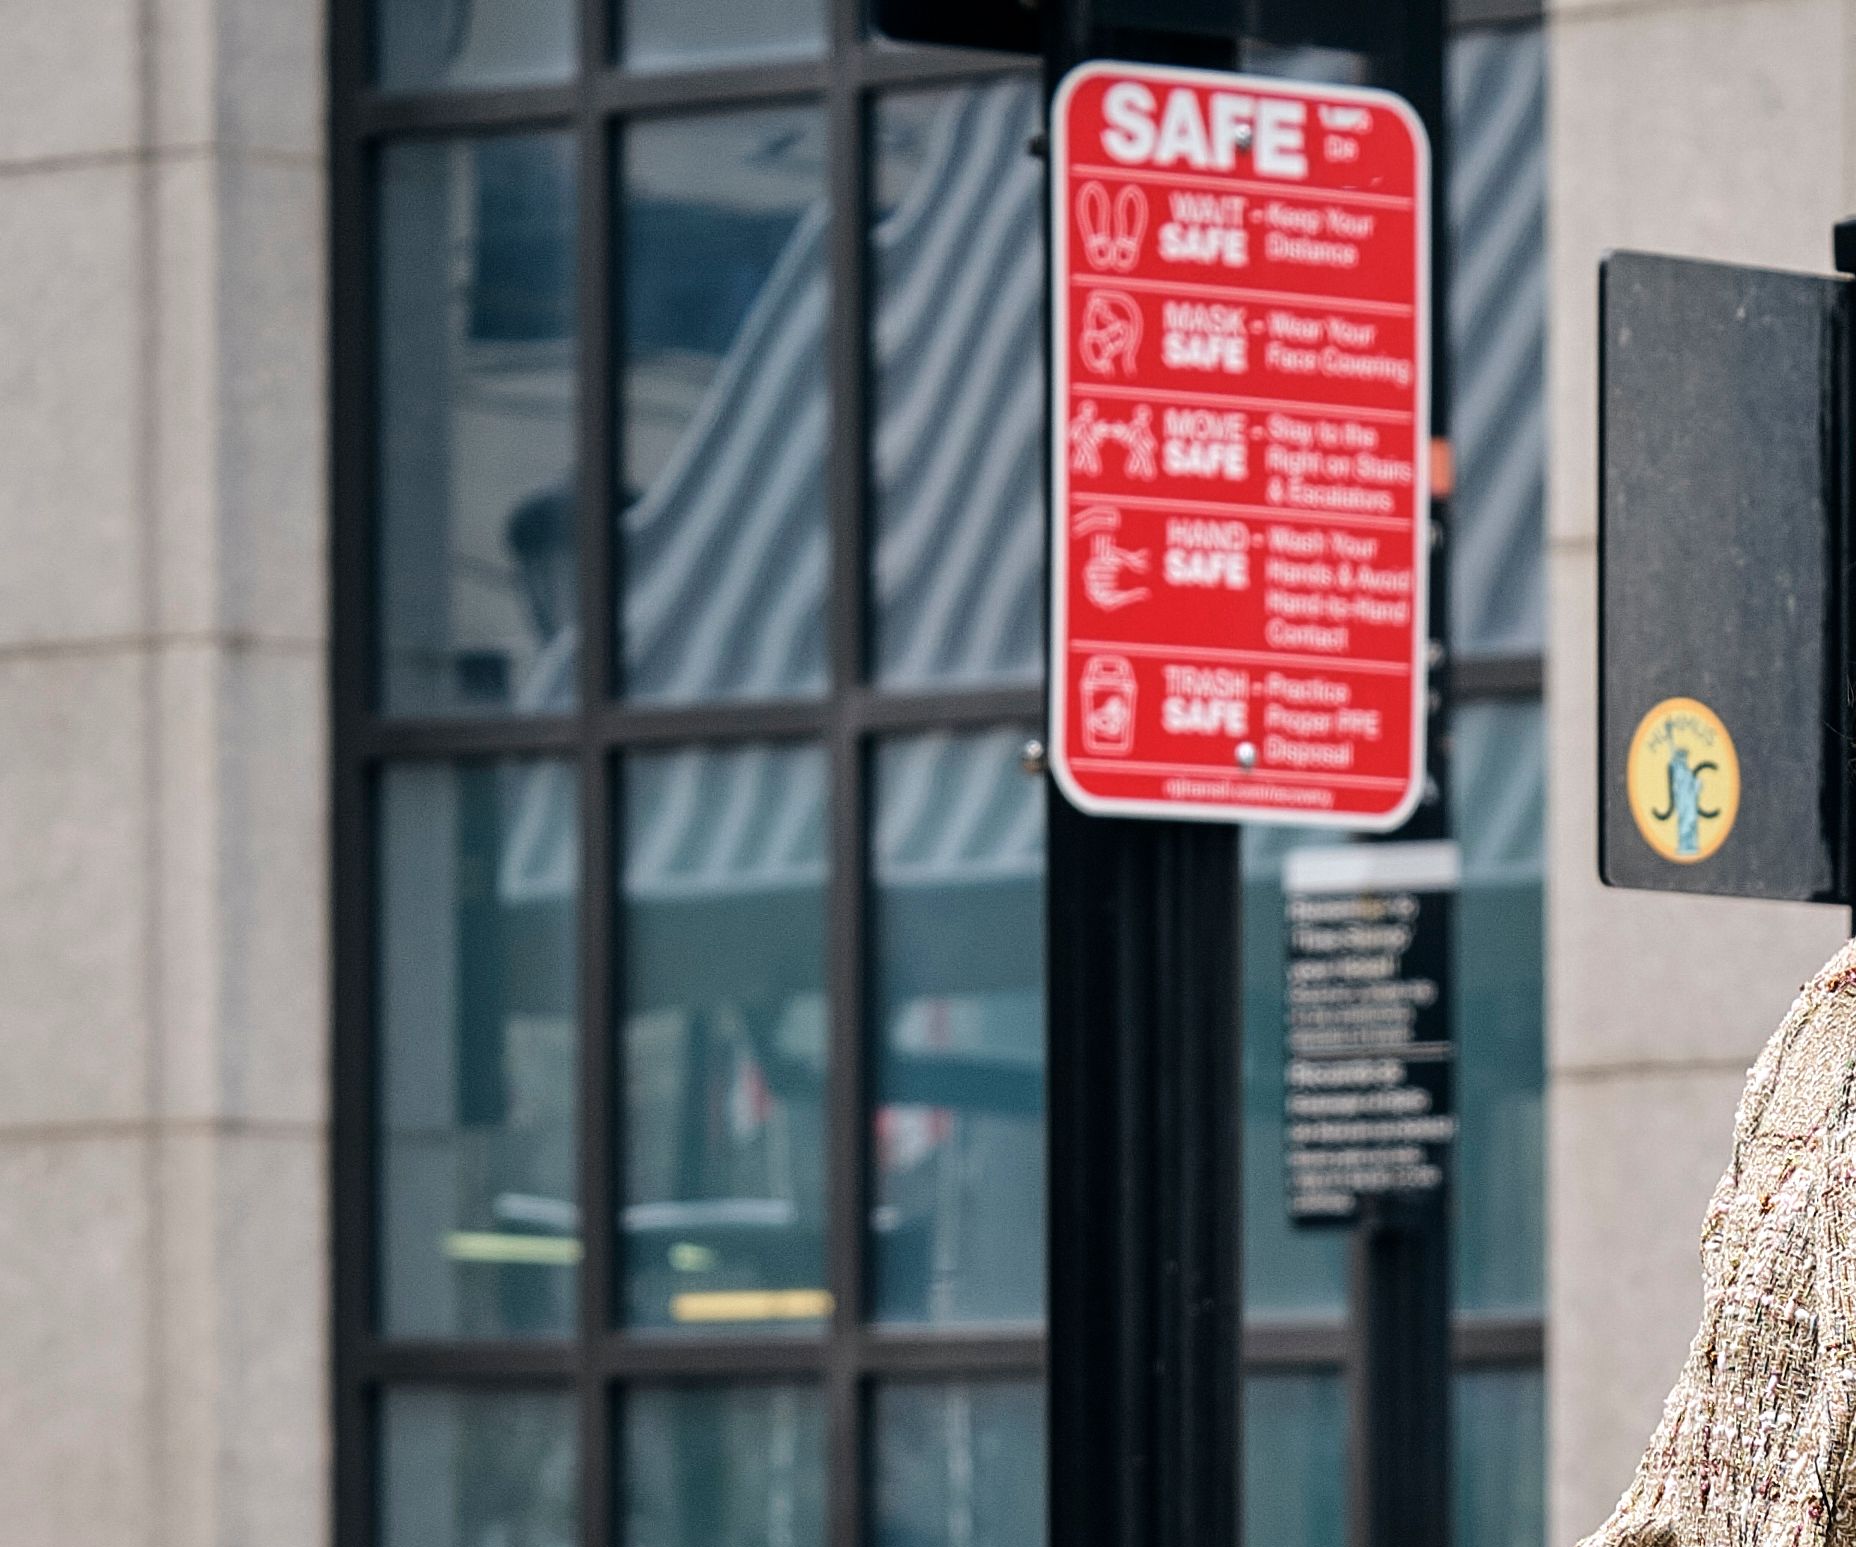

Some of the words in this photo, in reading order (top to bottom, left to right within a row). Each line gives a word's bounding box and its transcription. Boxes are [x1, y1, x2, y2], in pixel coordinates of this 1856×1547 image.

[1103, 83, 1307, 177] SAFE
[1170, 192, 1246, 226] WAIT
[1159, 223, 1247, 267] SAFE
[1163, 301, 1245, 334] MASK
[1162, 333, 1247, 374] SAFE
[1164, 409, 1246, 440] MOVE
[1267, 414, 1312, 446] Stay
[1163, 439, 1247, 480] SAFE
[1166, 518, 1248, 551] HAND
[1165, 550, 1249, 589] SAFE
[1164, 666, 1249, 699] TRASH
[1163, 697, 1247, 737] SAFE
